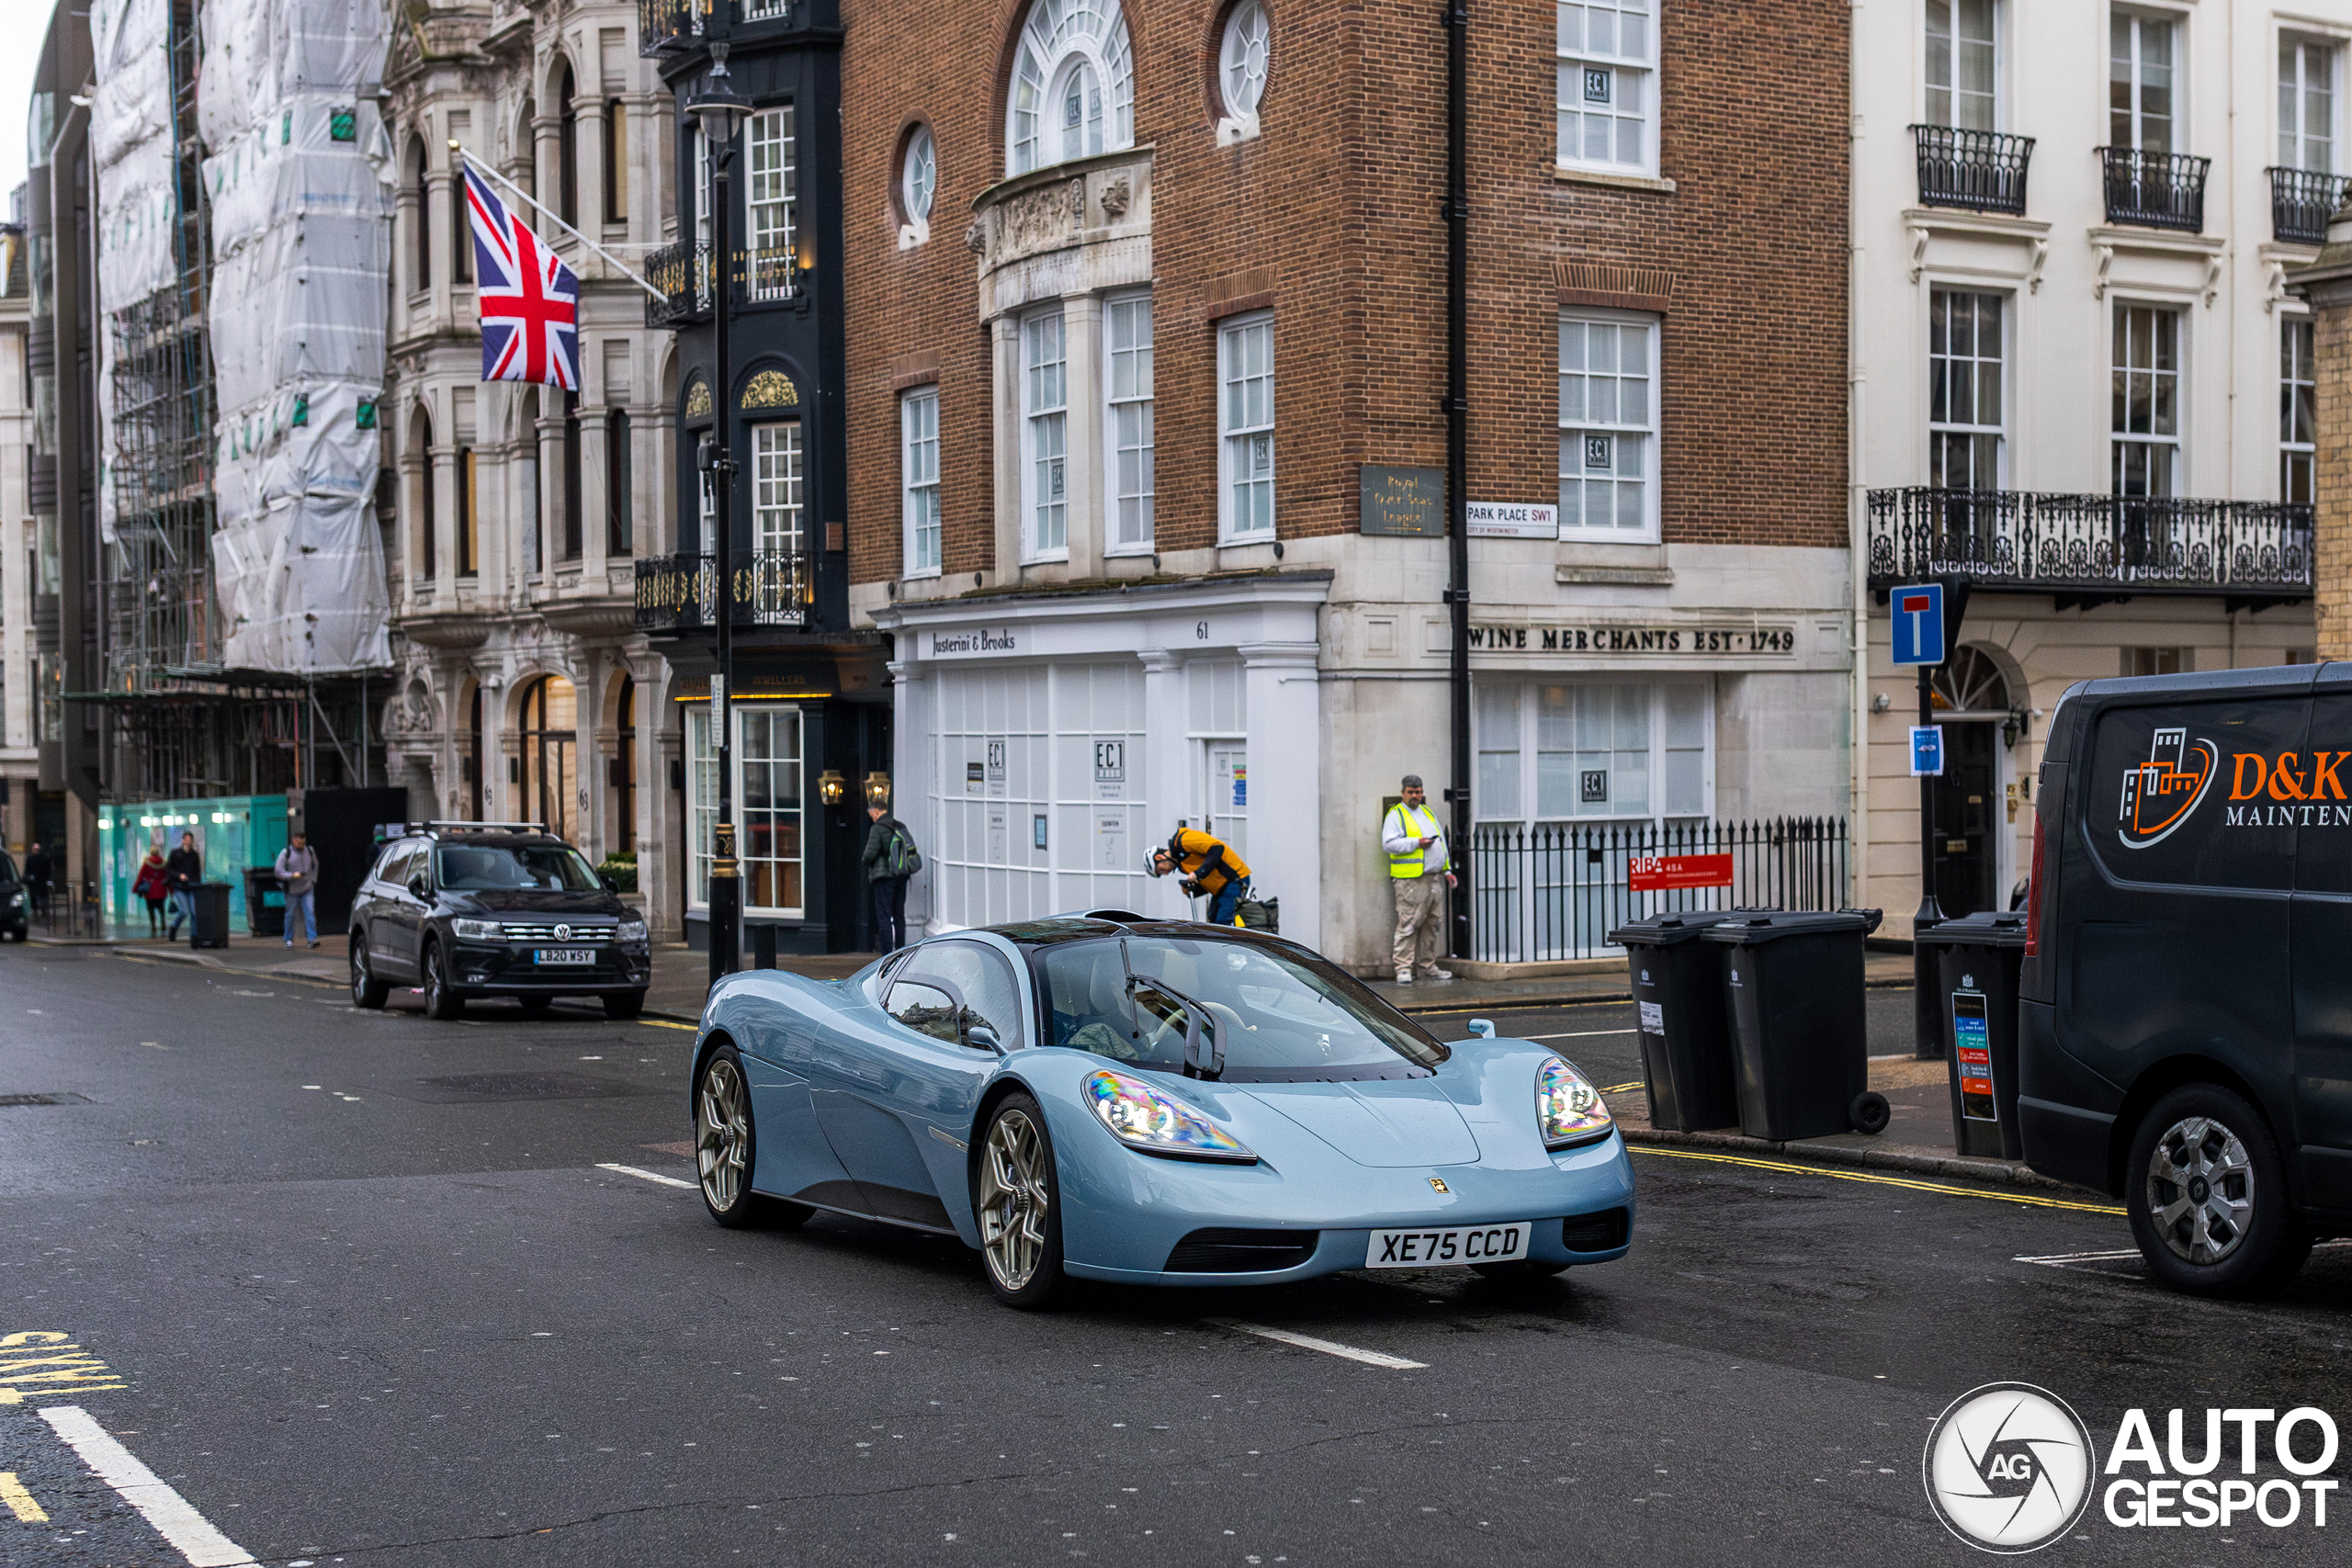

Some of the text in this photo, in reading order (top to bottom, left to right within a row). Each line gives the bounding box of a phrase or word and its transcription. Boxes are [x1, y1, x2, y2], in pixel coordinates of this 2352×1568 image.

[1467, 507, 1552, 522] PARK PLACE SW1
[1196, 621, 1209, 639] 61
[1468, 628, 1528, 649] WINE
[1543, 629, 1680, 650] MERCHANTS
[933, 632, 970, 657] Justerini
[981, 628, 1015, 650] Brooks
[1096, 743, 1123, 767] EC1
[2228, 751, 2352, 801] D&K
[2225, 806, 2352, 826] MAINTEN
[538, 950, 590, 962] LB20 WSY
[1380, 1228, 1520, 1262] XE75 CCD
